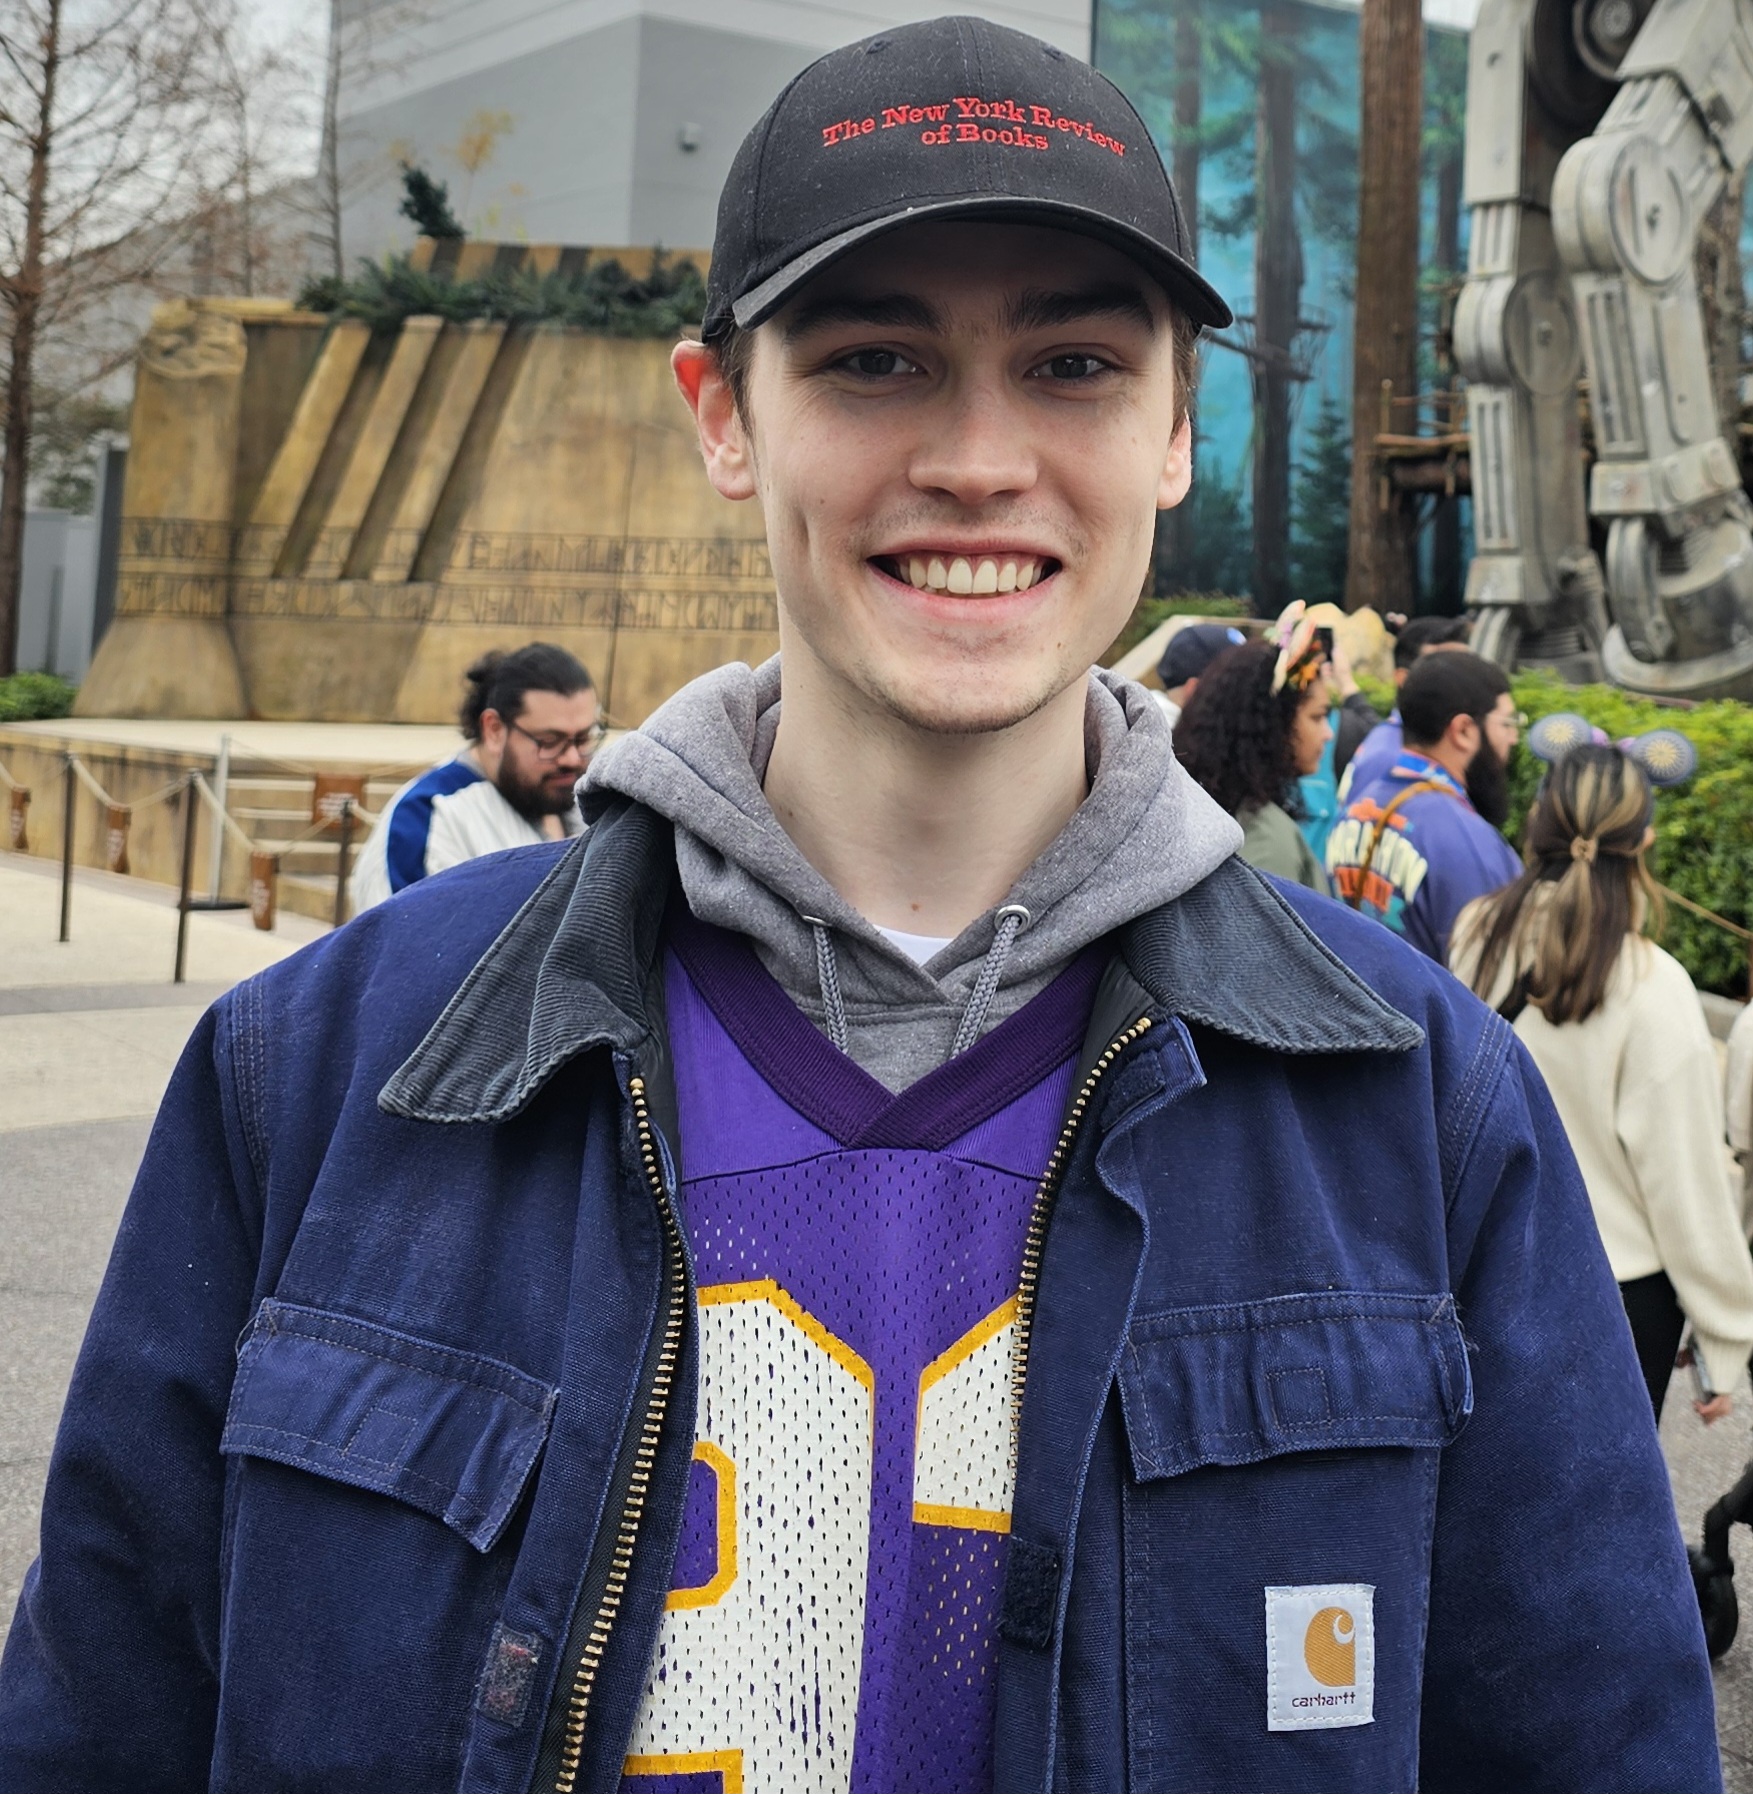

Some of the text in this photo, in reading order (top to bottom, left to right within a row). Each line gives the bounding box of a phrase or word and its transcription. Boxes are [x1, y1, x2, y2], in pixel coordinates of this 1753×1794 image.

[822, 97, 1126, 157] The New York Review
[921, 123, 1049, 150] of Books
[1291, 1692, 1356, 1707] carhartt
